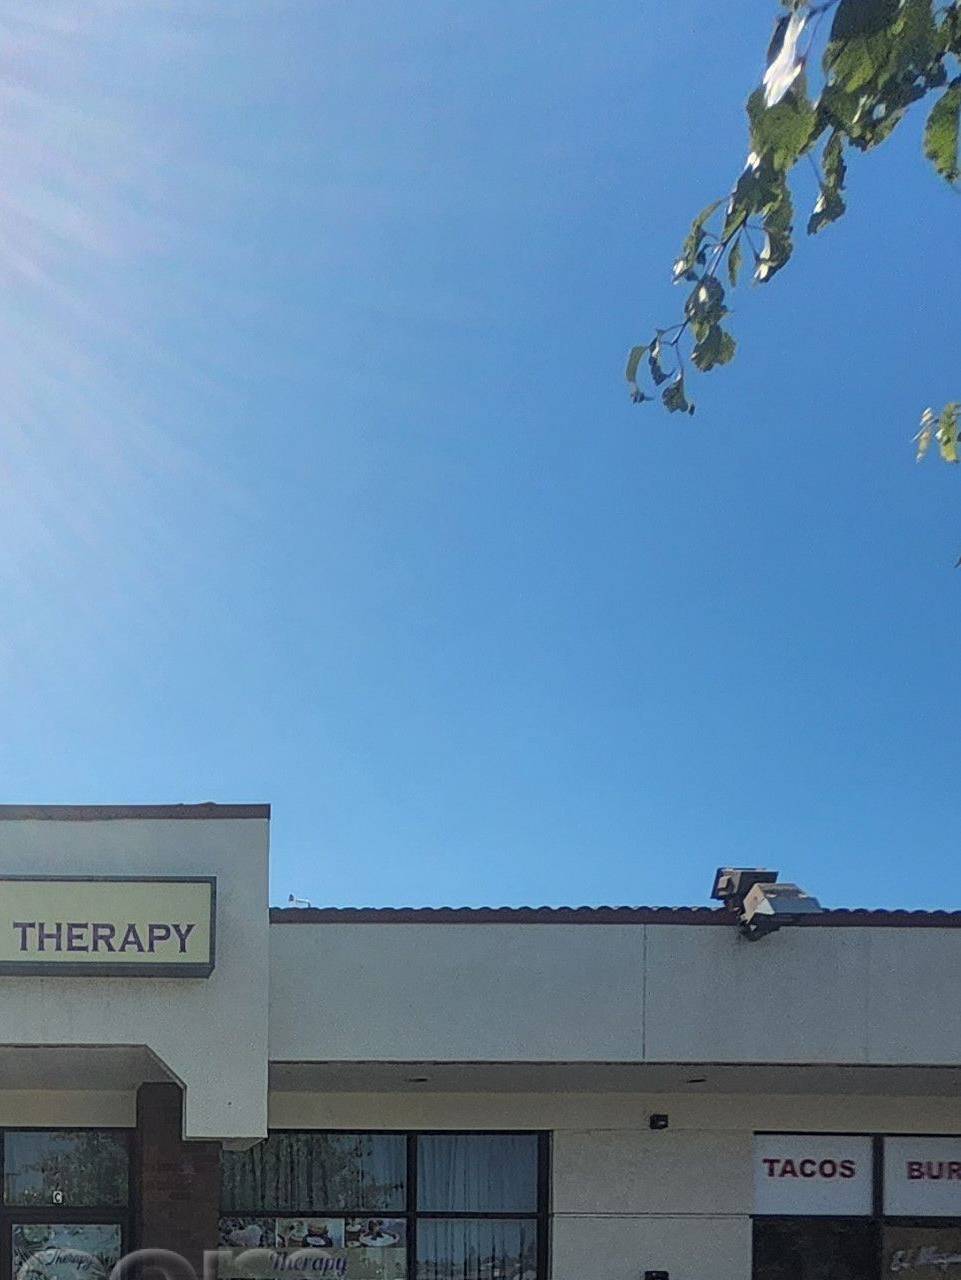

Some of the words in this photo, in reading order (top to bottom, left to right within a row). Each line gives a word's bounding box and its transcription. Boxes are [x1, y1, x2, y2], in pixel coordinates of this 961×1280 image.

[12, 920, 197, 954] THERAPY
[762, 1158, 856, 1179] TACOS
[270, 1250, 347, 1277] Therapy
